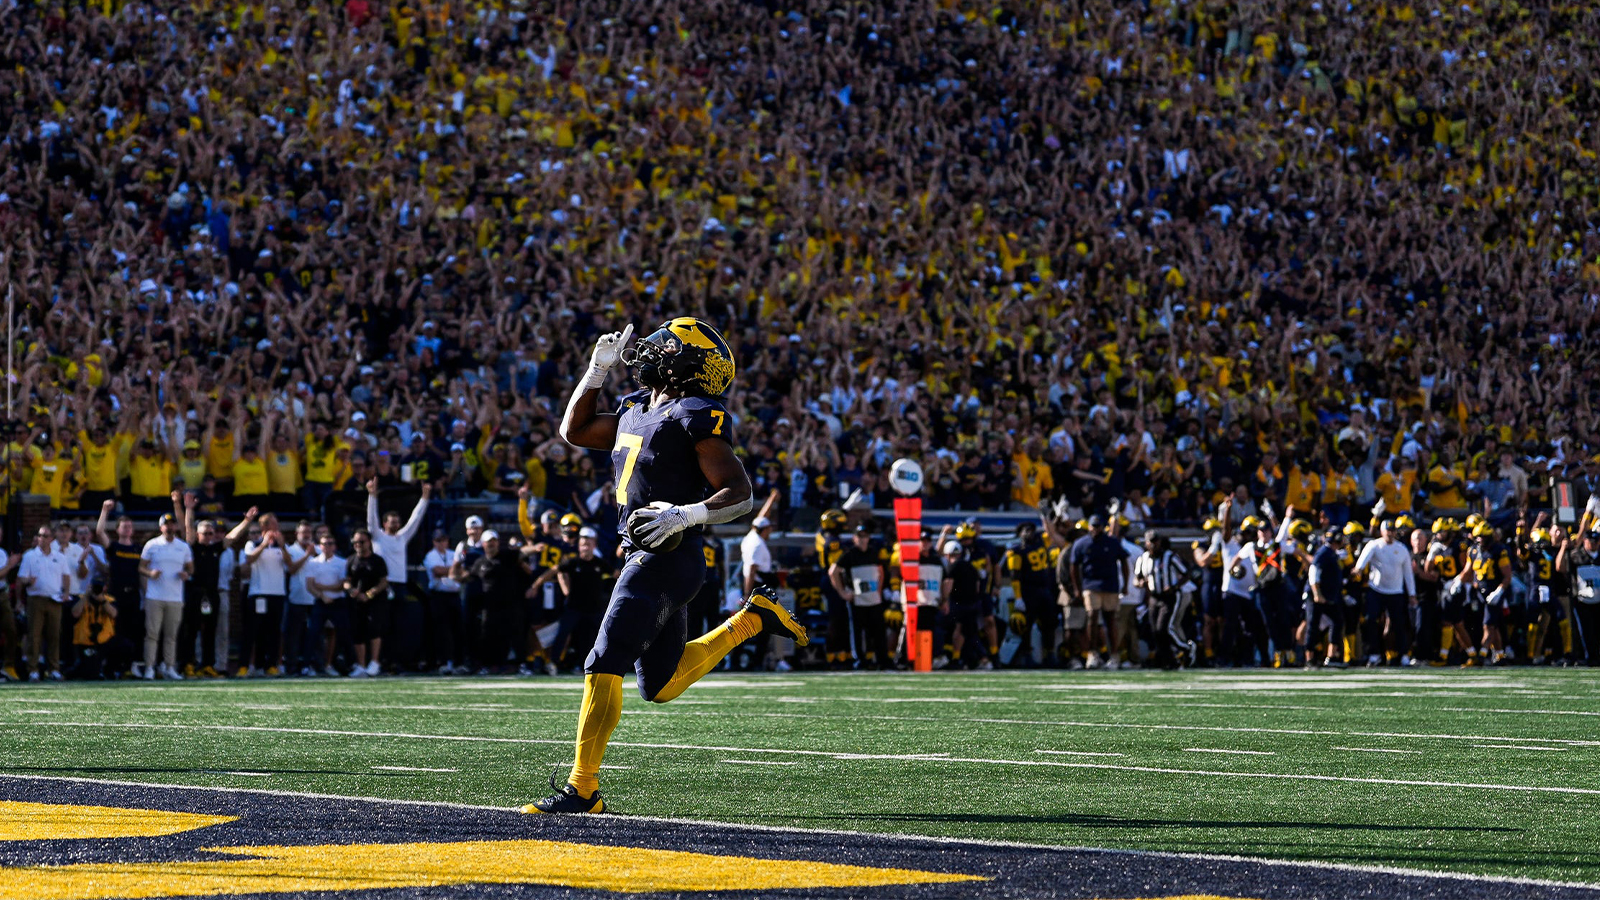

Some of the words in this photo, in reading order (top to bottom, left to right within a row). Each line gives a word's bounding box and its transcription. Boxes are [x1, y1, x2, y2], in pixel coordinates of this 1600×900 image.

[711, 409, 725, 435] 7
[410, 461, 429, 480] 12
[614, 432, 644, 506] 7
[540, 544, 562, 568] 13
